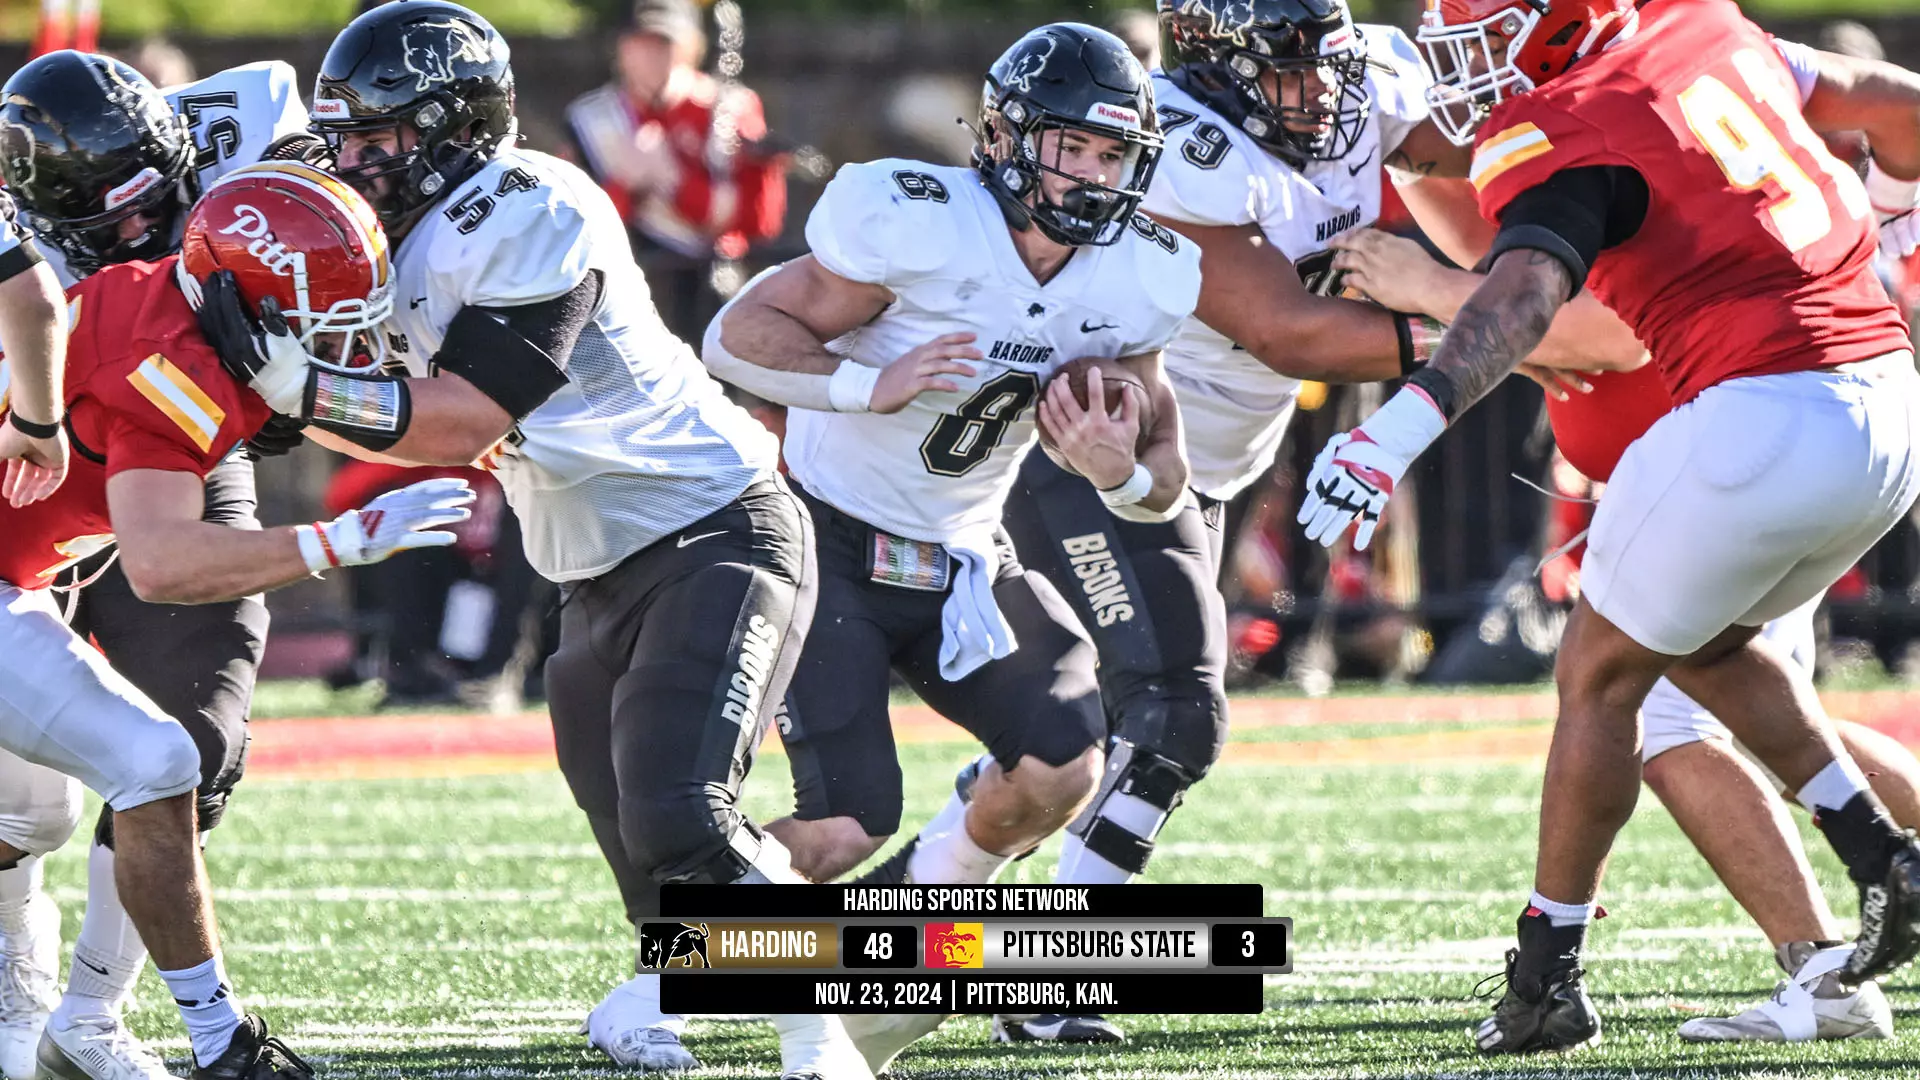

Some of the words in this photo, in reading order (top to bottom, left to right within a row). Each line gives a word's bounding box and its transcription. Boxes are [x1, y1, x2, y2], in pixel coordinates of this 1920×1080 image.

[1097, 105, 1136, 124] Riddell
[1157, 104, 1233, 170] 79
[443, 166, 540, 236] 54
[892, 169, 950, 204] 8
[217, 204, 299, 277] Pitt
[1129, 211, 1179, 255] 8
[1315, 204, 1361, 242] HARDING
[988, 340, 1053, 364] HARDING
[919, 368, 1041, 478] 8
[1062, 532, 1135, 628] BISONS
[721, 614, 779, 738] BISONS
